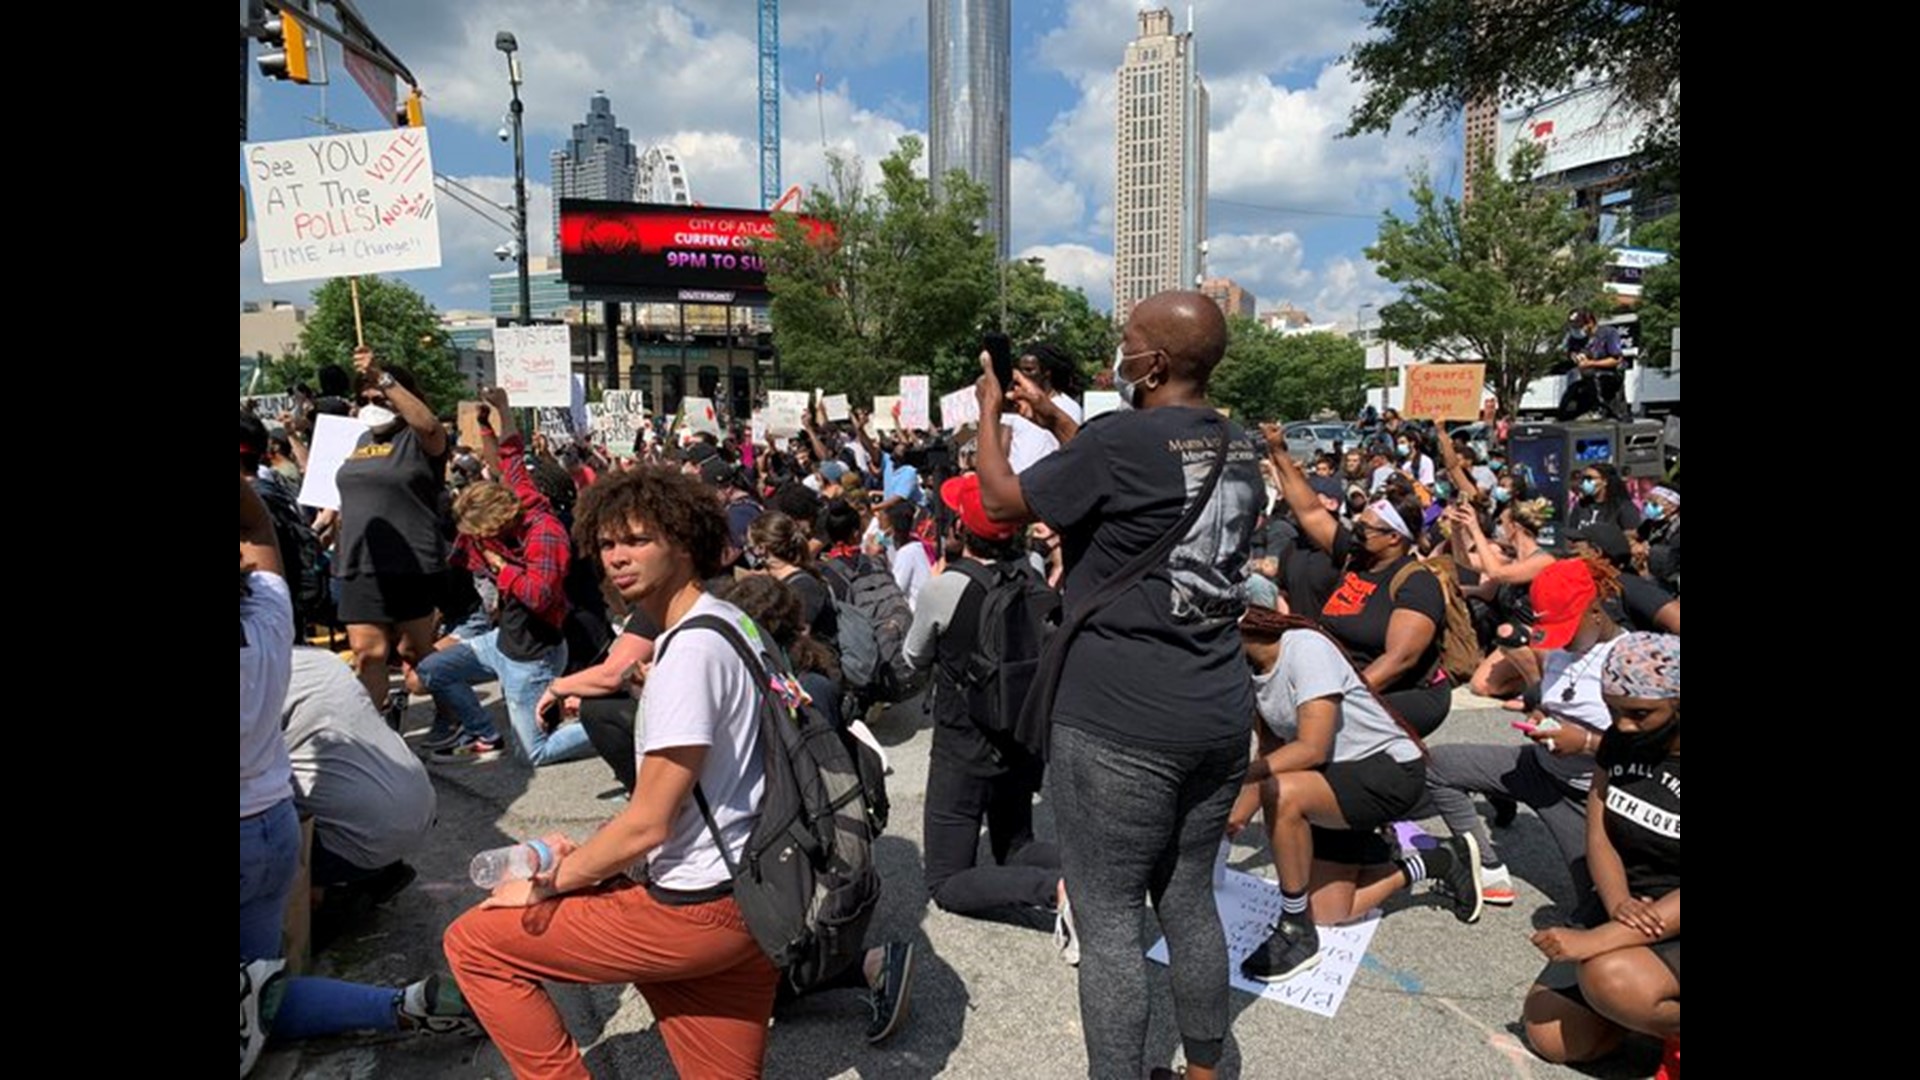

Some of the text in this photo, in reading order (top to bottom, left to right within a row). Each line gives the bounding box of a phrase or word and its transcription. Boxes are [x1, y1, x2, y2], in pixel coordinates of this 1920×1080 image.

[251, 138, 369, 181] See YOU
[364, 131, 422, 182] VOTE
[267, 183, 305, 215] AT
[674, 232, 729, 248] CURFEW
[689, 218, 776, 235] CITY OF ATLAN
[268, 243, 320, 270] TIME
[666, 251, 707, 268] 9PM
[712, 254, 736, 270] TO
[1627, 762, 1653, 778] ALL
[1608, 791, 1680, 834] ITH LOVE
